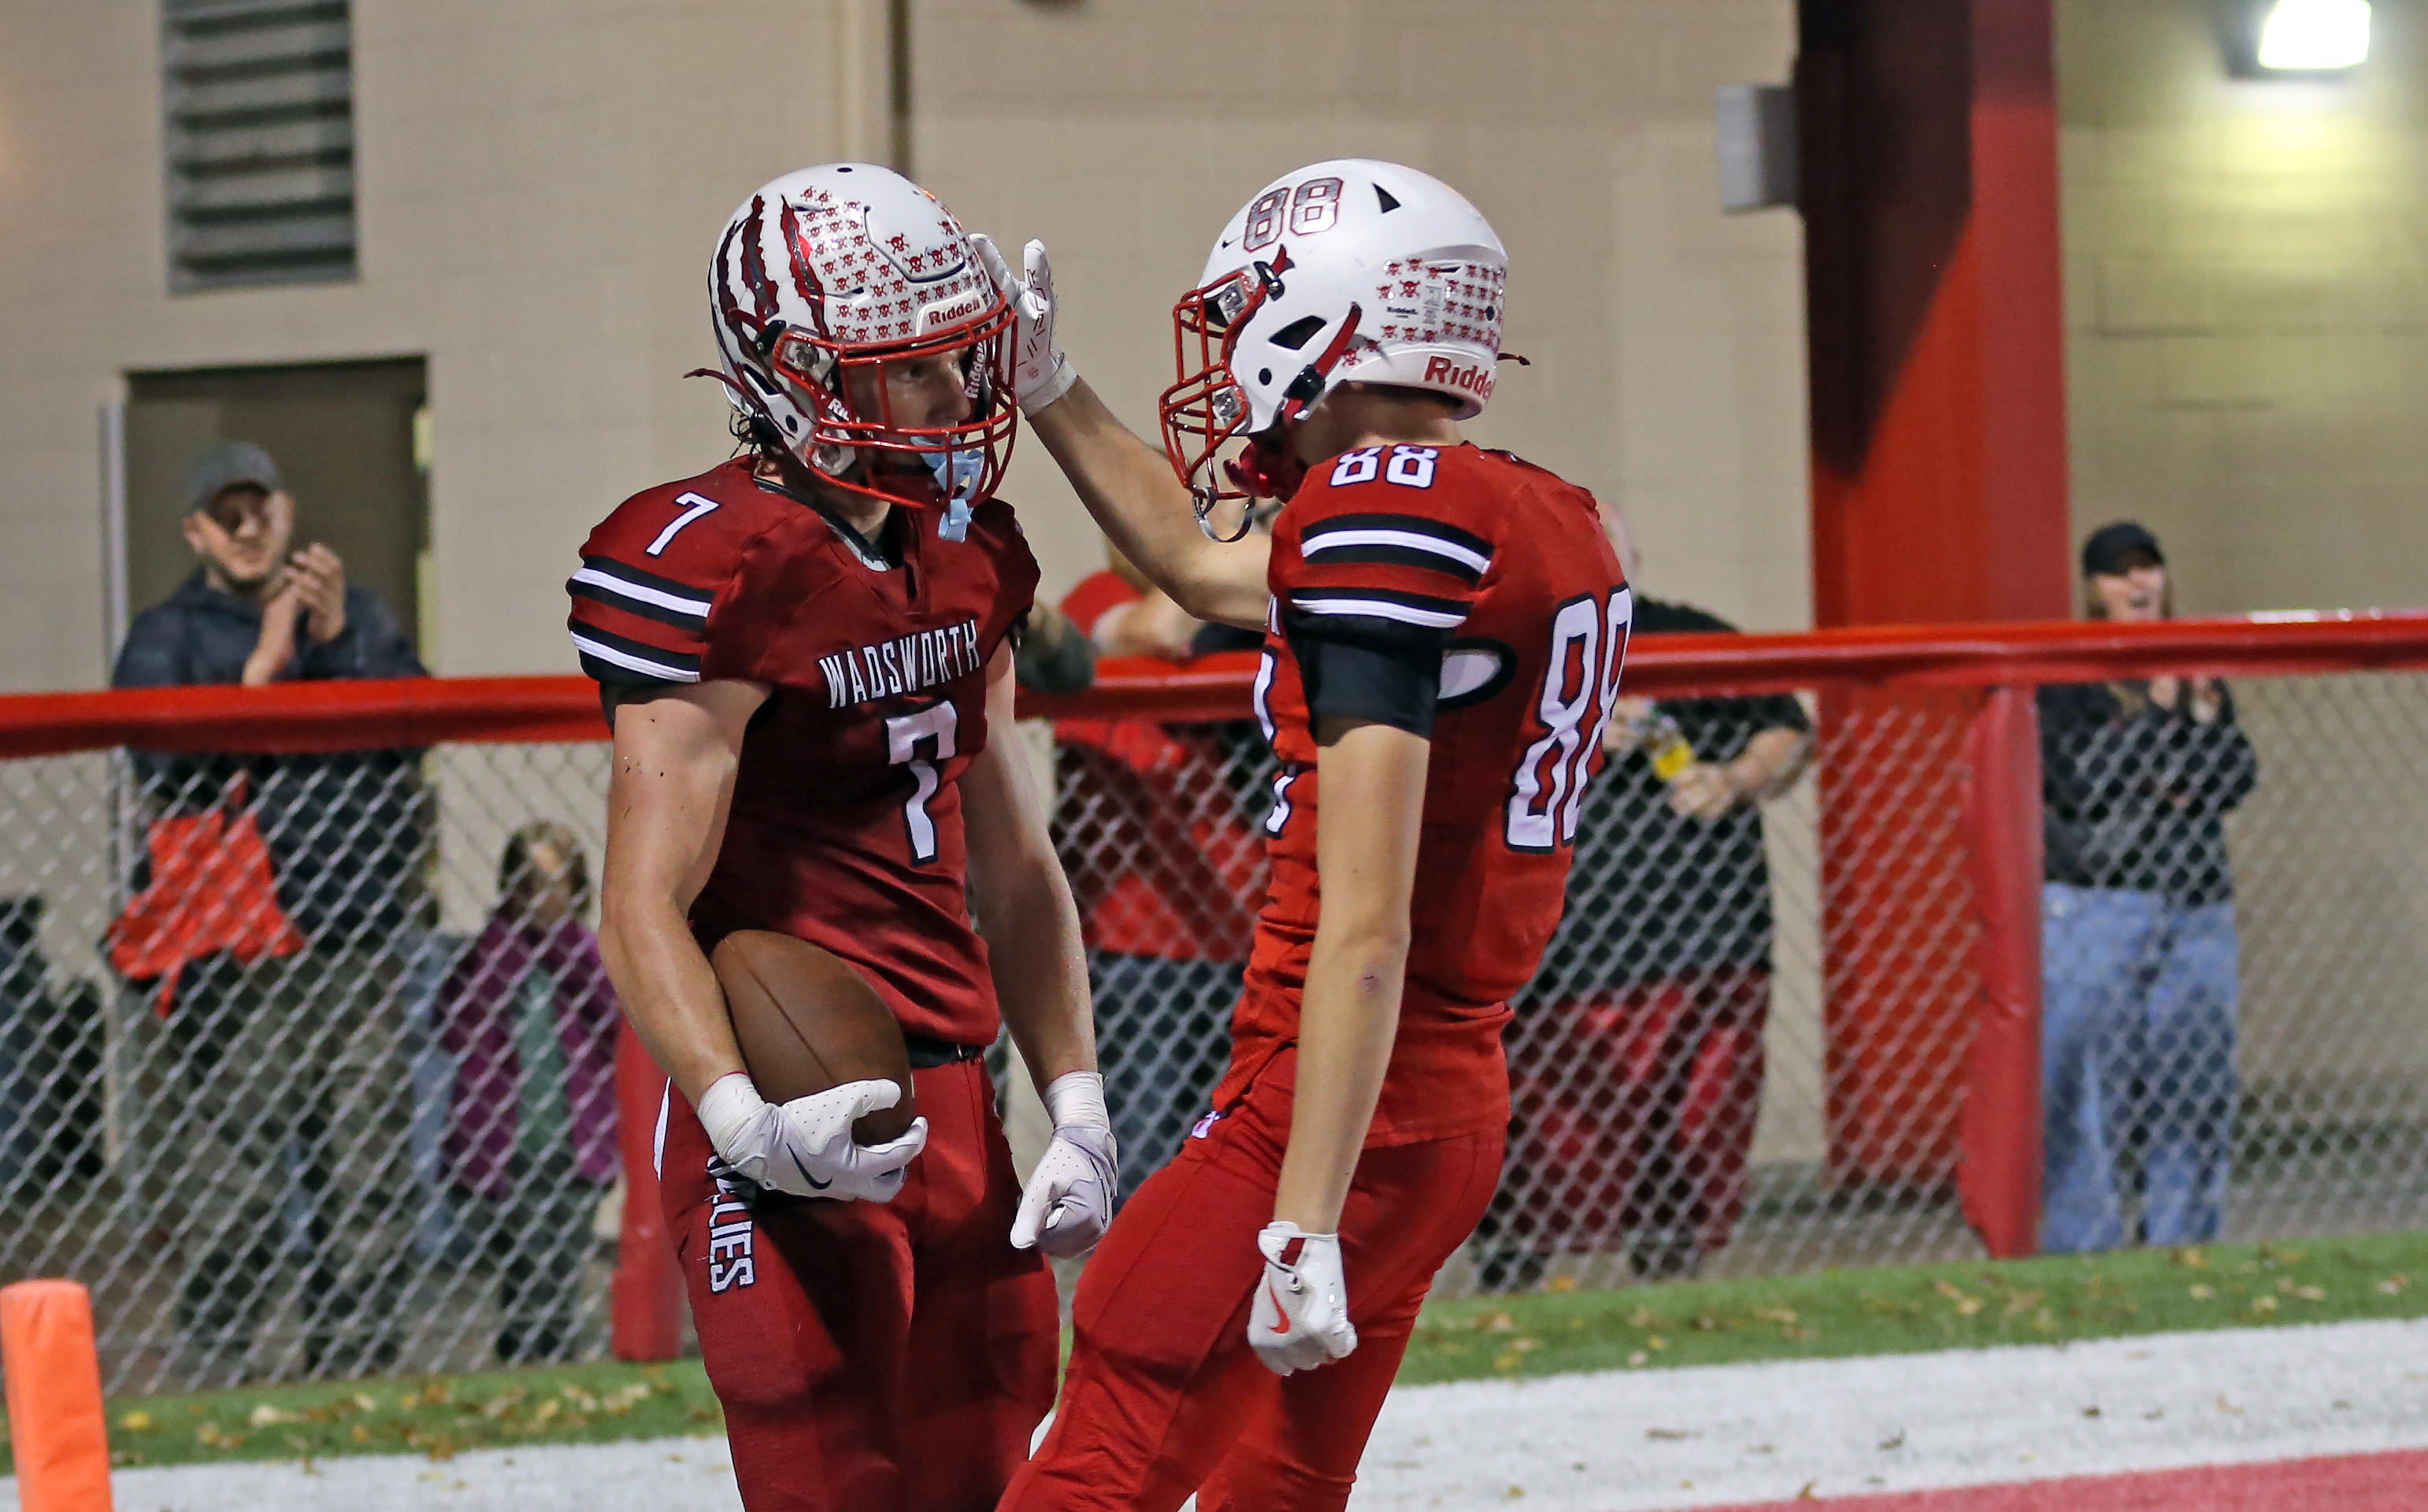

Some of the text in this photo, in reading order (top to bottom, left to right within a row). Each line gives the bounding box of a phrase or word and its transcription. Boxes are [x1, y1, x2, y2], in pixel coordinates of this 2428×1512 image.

[1244, 176, 1344, 252] 88
[929, 298, 980, 325] Riddell
[963, 341, 984, 399] Riddell
[1329, 443, 1440, 490] 88
[645, 490, 721, 557] 7
[818, 618, 980, 710] WADSWORTH
[884, 696, 959, 865] 7
